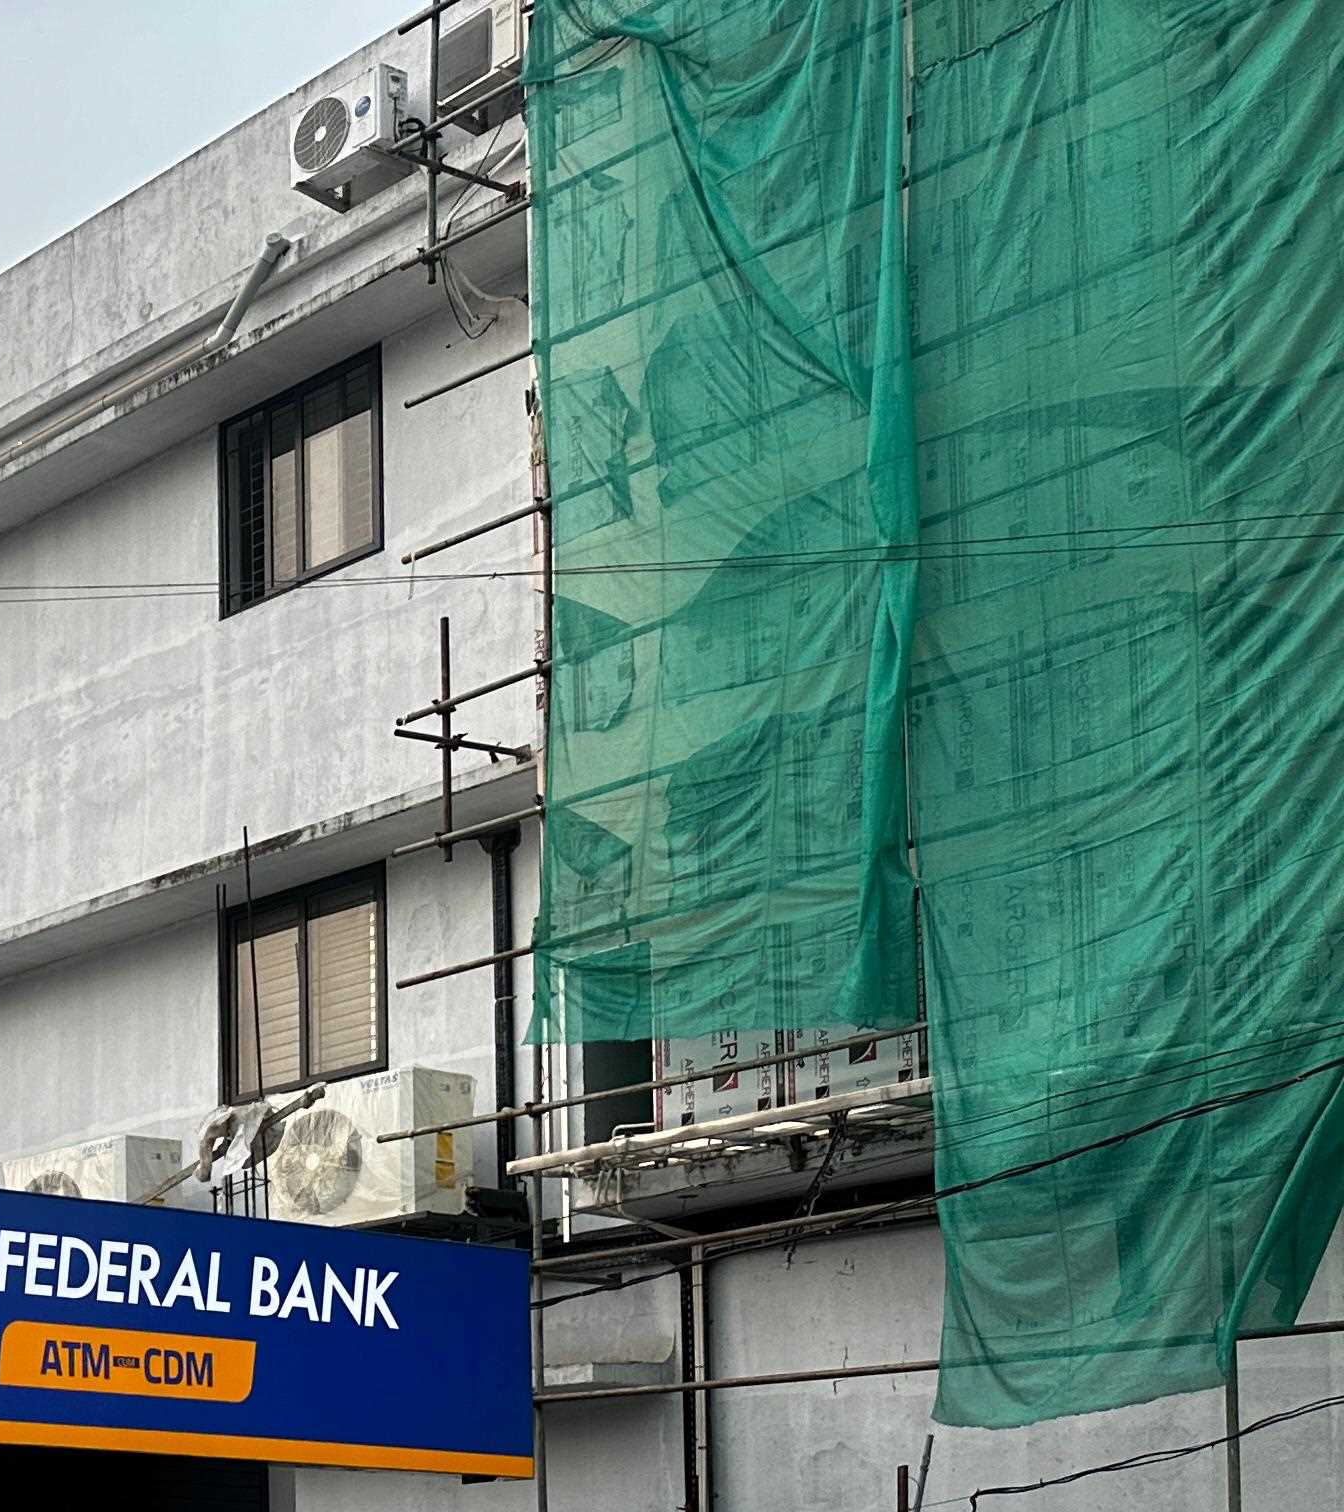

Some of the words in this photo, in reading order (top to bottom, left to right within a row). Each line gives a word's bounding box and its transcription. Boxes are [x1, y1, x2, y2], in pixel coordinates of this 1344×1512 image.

[250, 1258, 400, 1331] BANK
[40, 1341, 110, 1380] ATM
[144, 1348, 213, 1388] CDM
